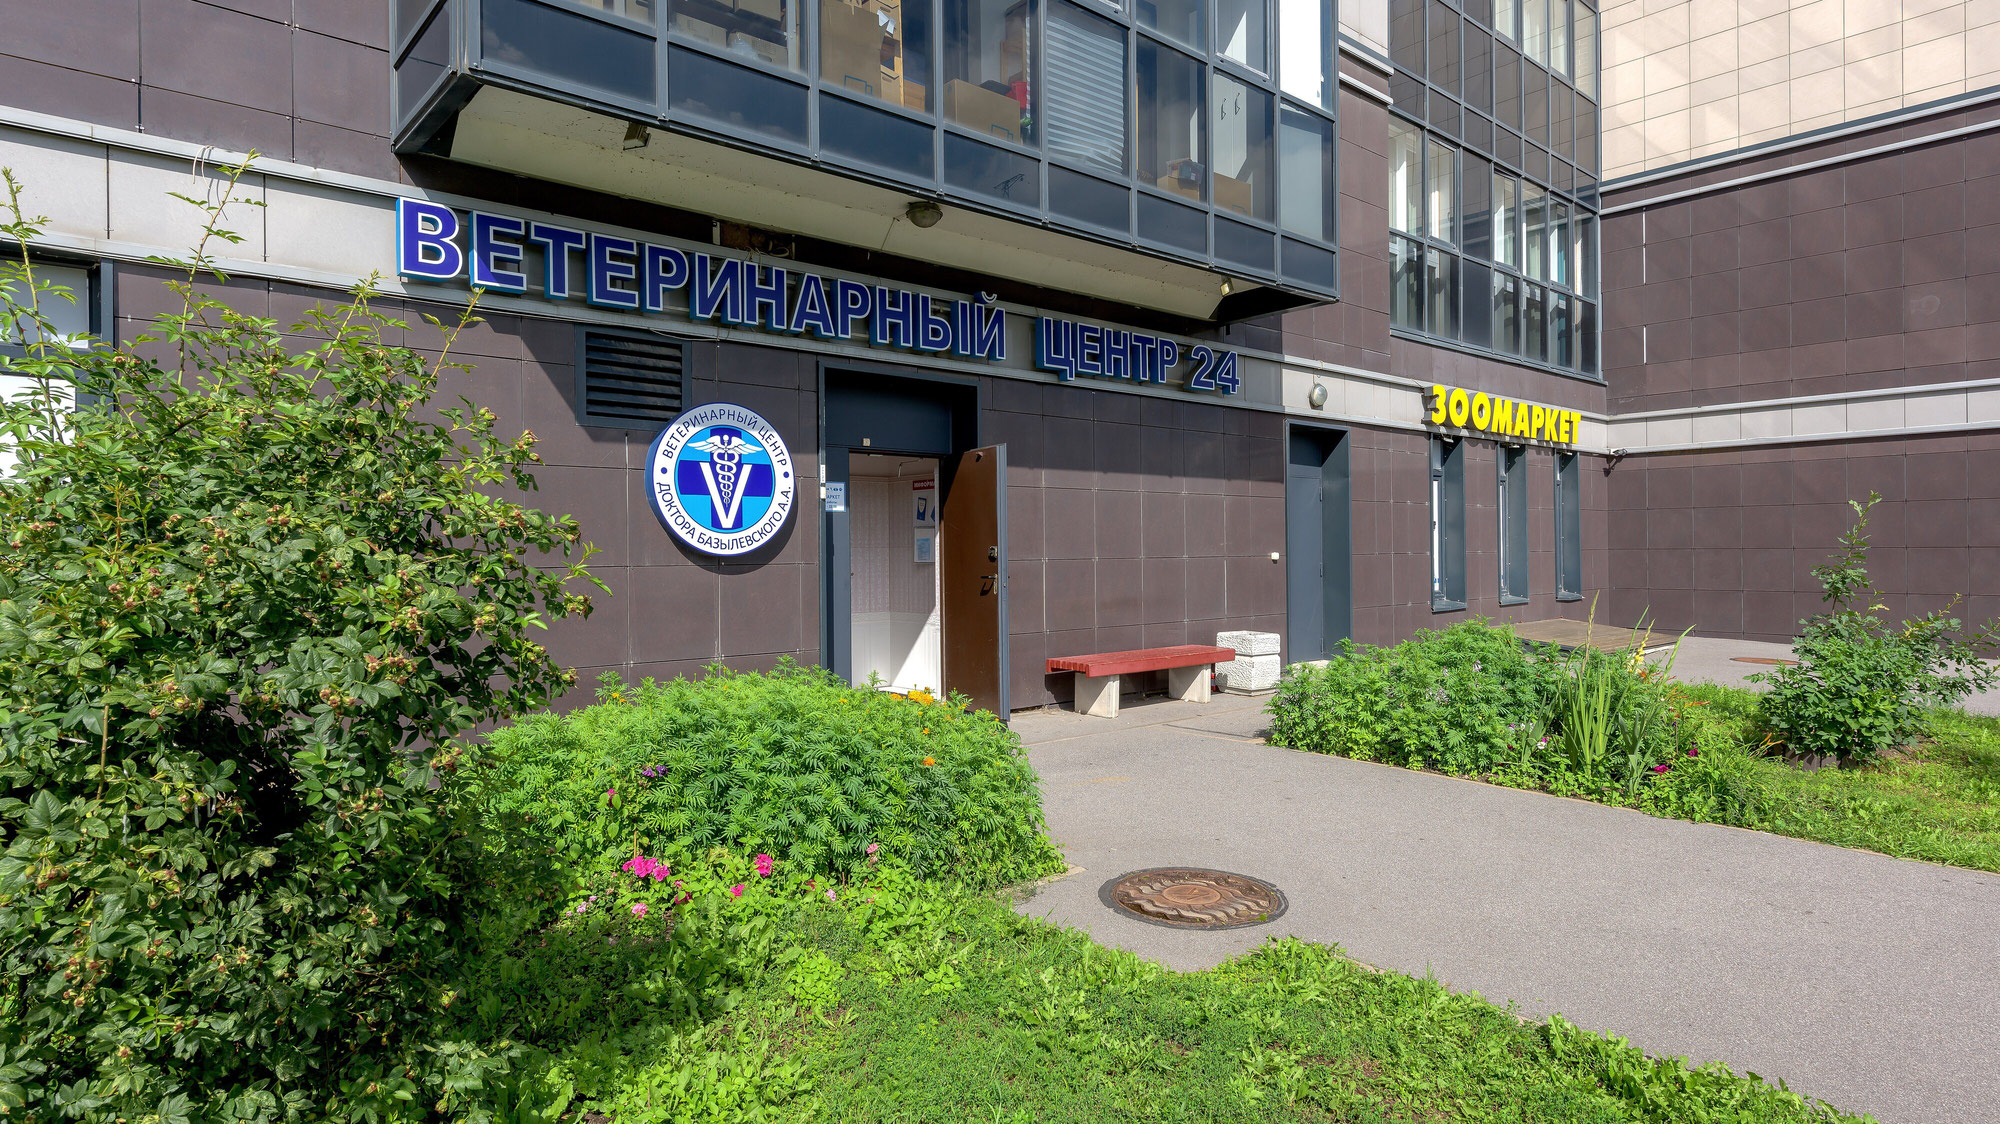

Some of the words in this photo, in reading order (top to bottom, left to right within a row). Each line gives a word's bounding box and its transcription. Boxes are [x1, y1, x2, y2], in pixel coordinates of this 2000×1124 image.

[397, 196, 1006, 361] ВЕТЕРИНАРНЫЙ
[1040, 316, 1179, 384] ЦЕНТР
[1189, 345, 1241, 394] 24
[662, 408, 758, 460] ВЕТЕРИНАРНЫЙ
[757, 425, 788, 467] ЦЕНТР
[1430, 384, 1582, 445] ЗООМАРКЕТ
[656, 482, 697, 540] ДОКТОРА
[696, 511, 783, 551] БАЗЫЛЕВСКОГО
[781, 486, 792, 511] А.А.
